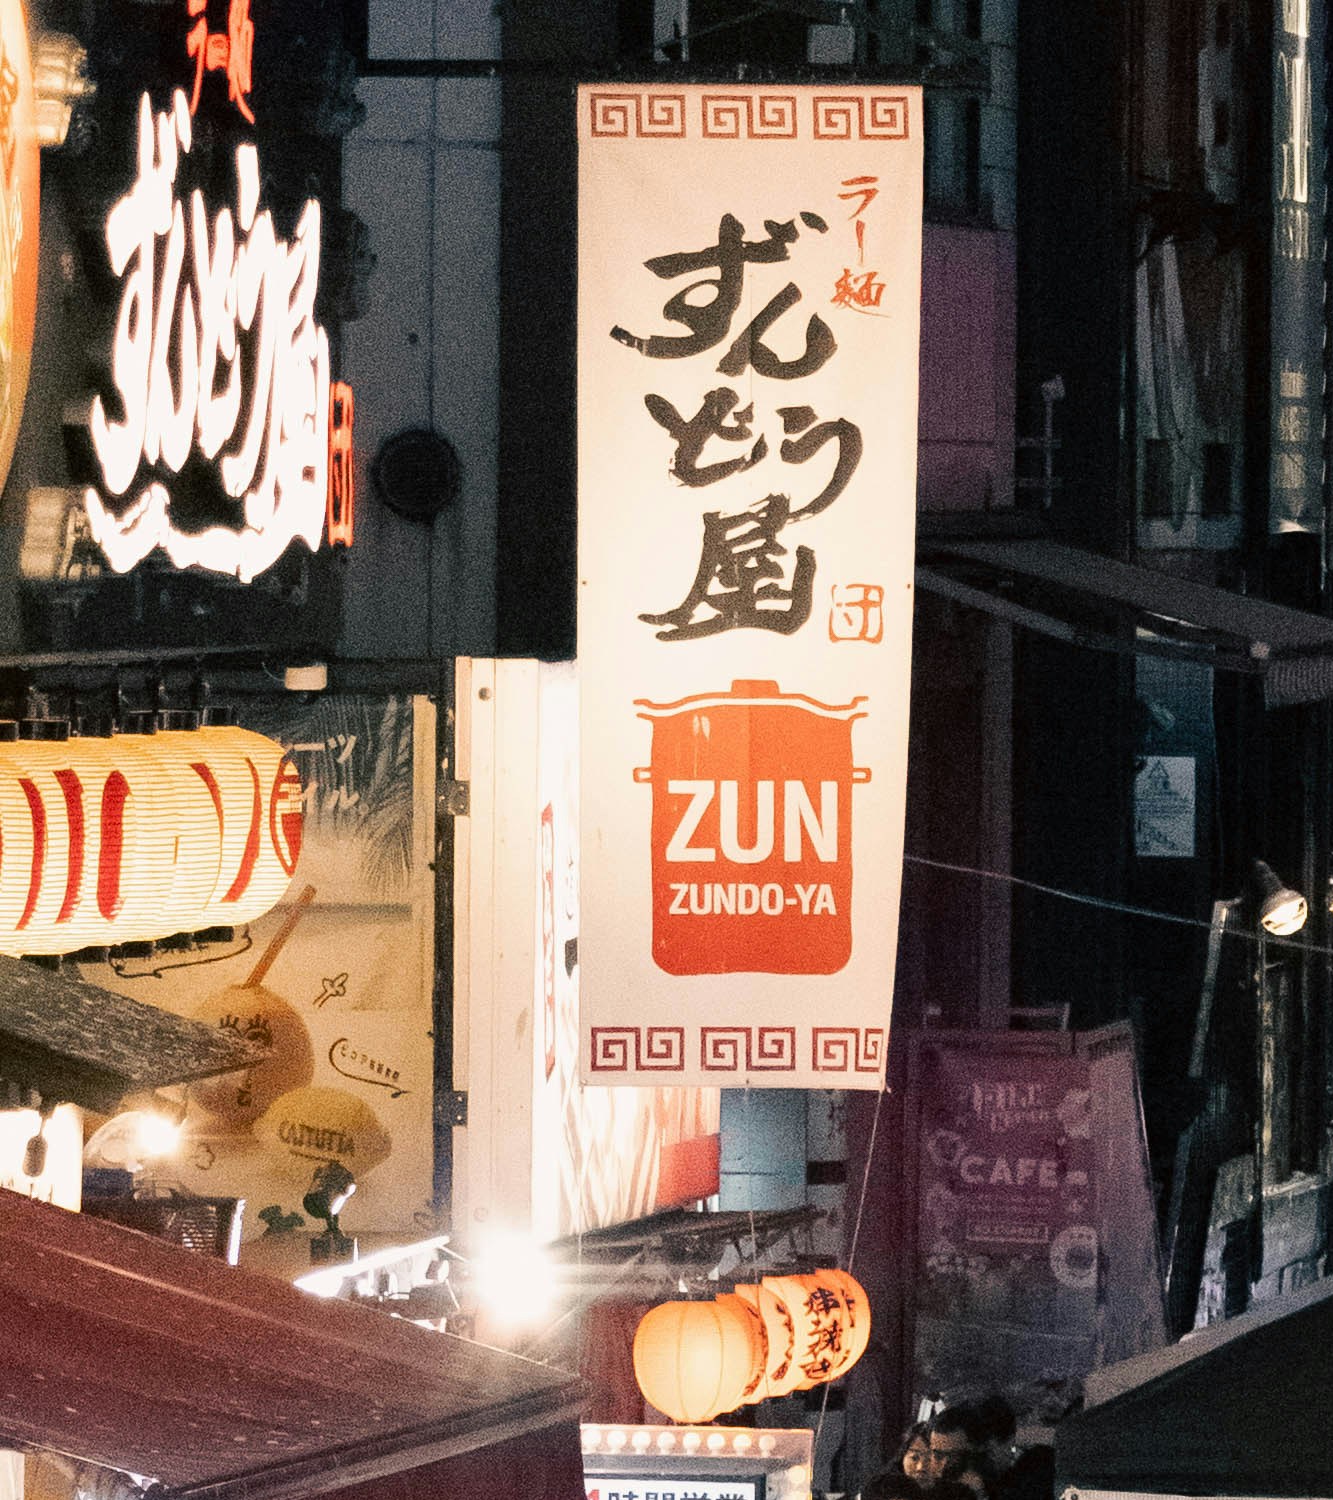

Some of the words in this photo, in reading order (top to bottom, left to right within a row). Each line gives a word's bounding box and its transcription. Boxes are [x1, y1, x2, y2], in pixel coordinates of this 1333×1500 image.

[664, 779, 839, 865] ZUN
[669, 883, 837, 917] ZUNDO-YA
[959, 1154, 1060, 1189] CAFE
